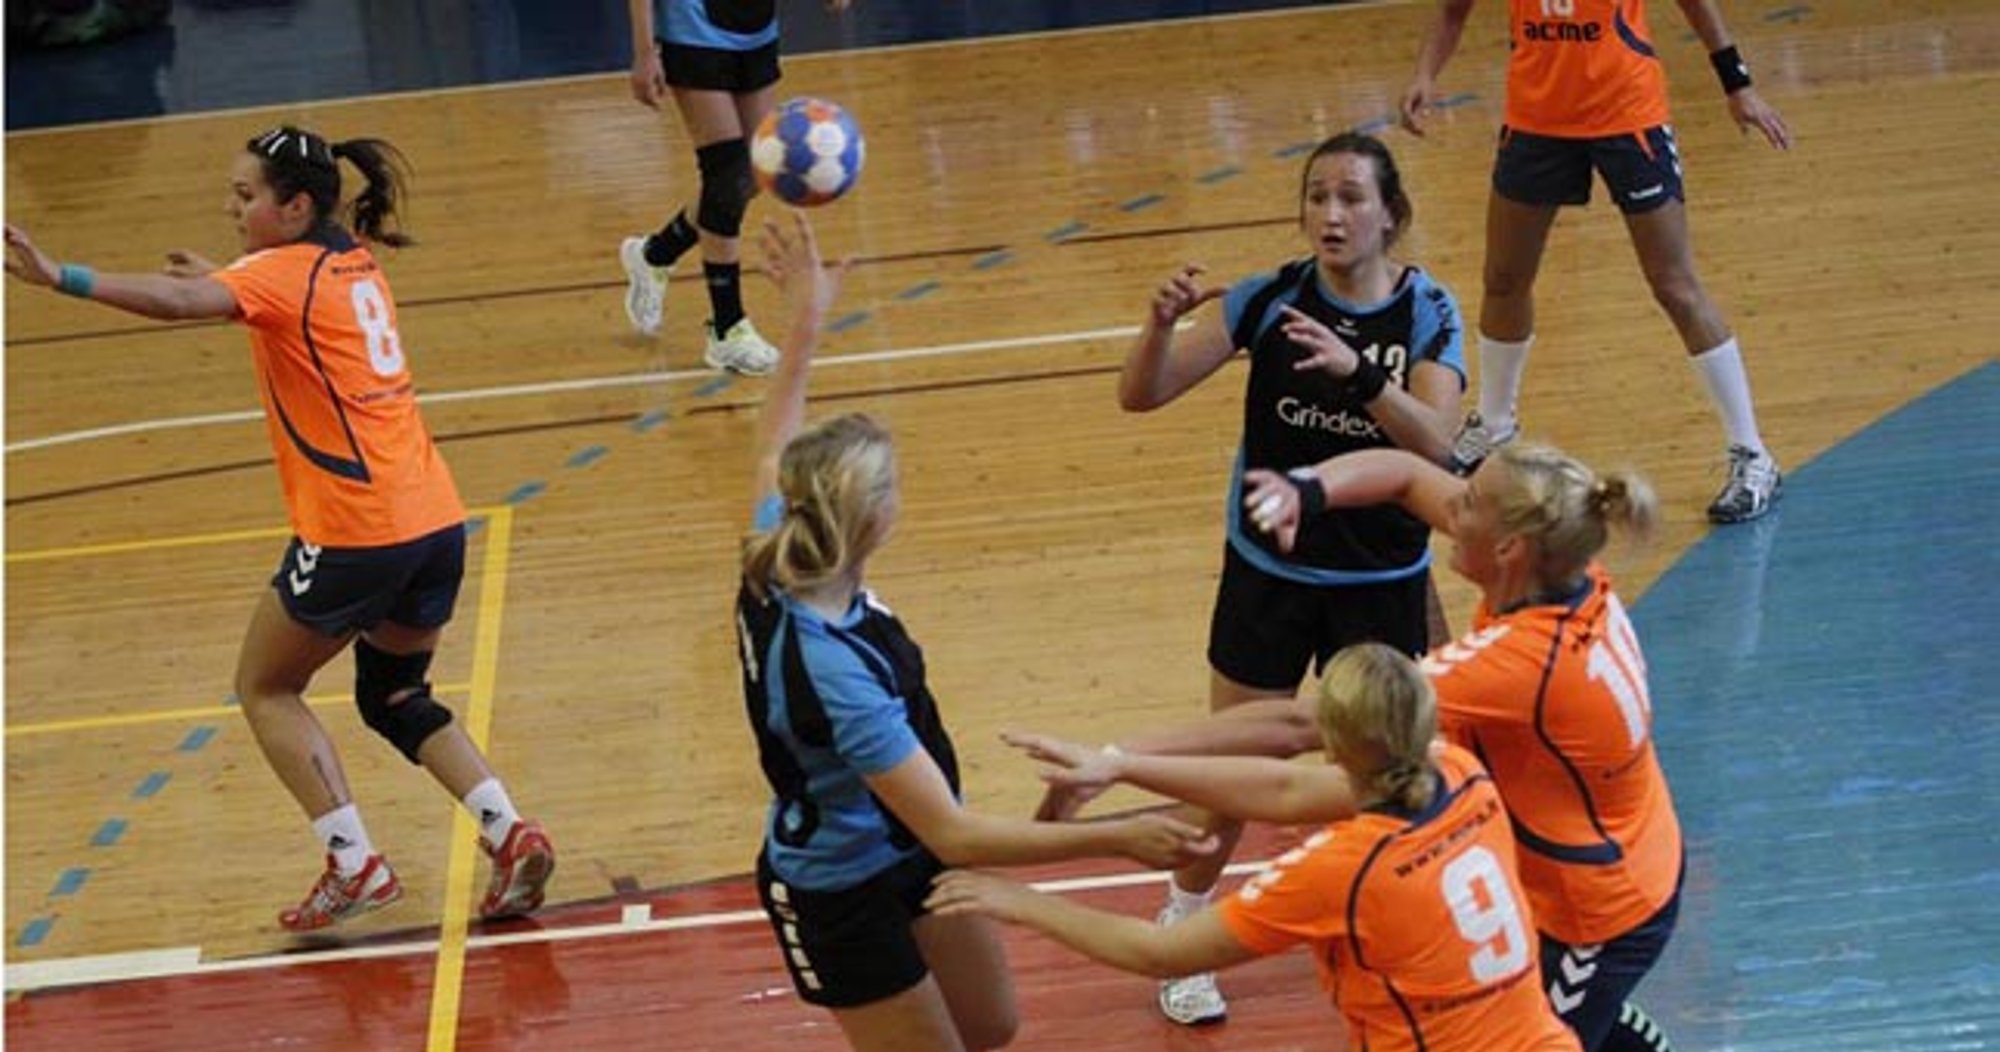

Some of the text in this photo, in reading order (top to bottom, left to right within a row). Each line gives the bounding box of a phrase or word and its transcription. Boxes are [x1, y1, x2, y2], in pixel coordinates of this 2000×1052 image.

[1523, 21, 1601, 42] acme
[352, 279, 405, 377] 8
[1277, 397, 1380, 438] Grindex
[1442, 845, 1529, 986] 9
